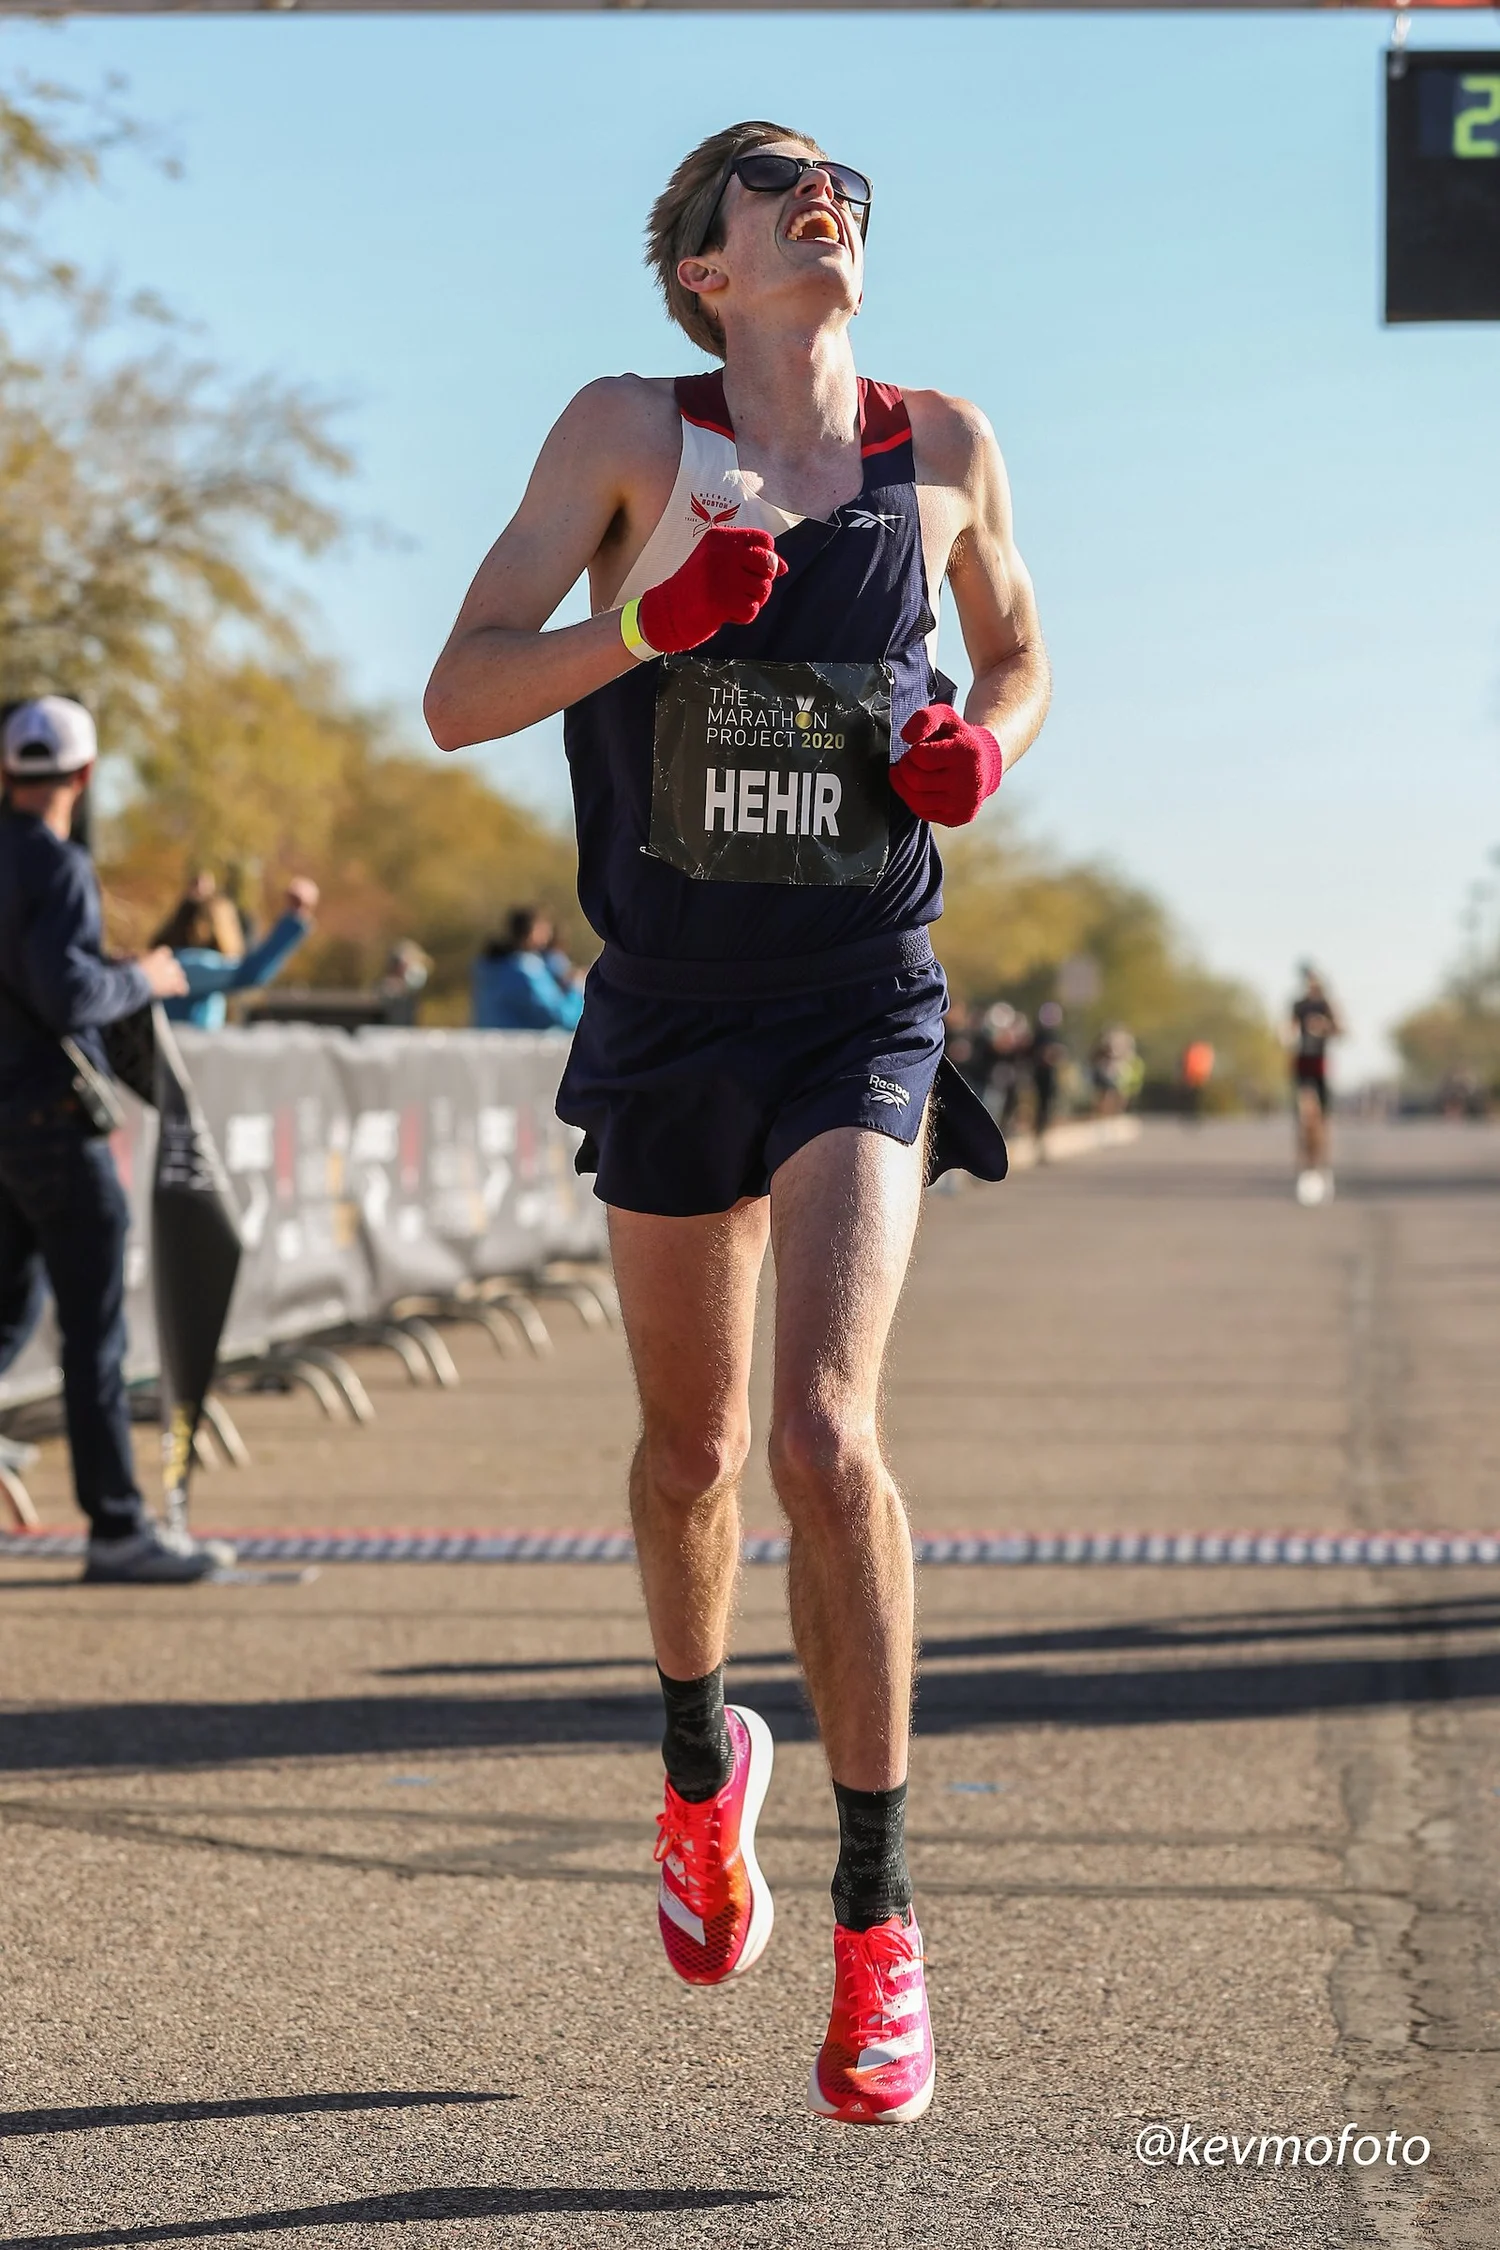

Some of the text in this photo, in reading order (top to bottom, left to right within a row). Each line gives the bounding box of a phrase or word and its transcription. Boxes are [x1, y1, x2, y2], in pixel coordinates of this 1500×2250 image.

[1454, 75, 1500, 158] 2
[709, 687, 749, 707] THE
[707, 708, 828, 730] MARATHON
[706, 728, 845, 750] PROJECT 2020
[704, 767, 843, 837] HEHIR
